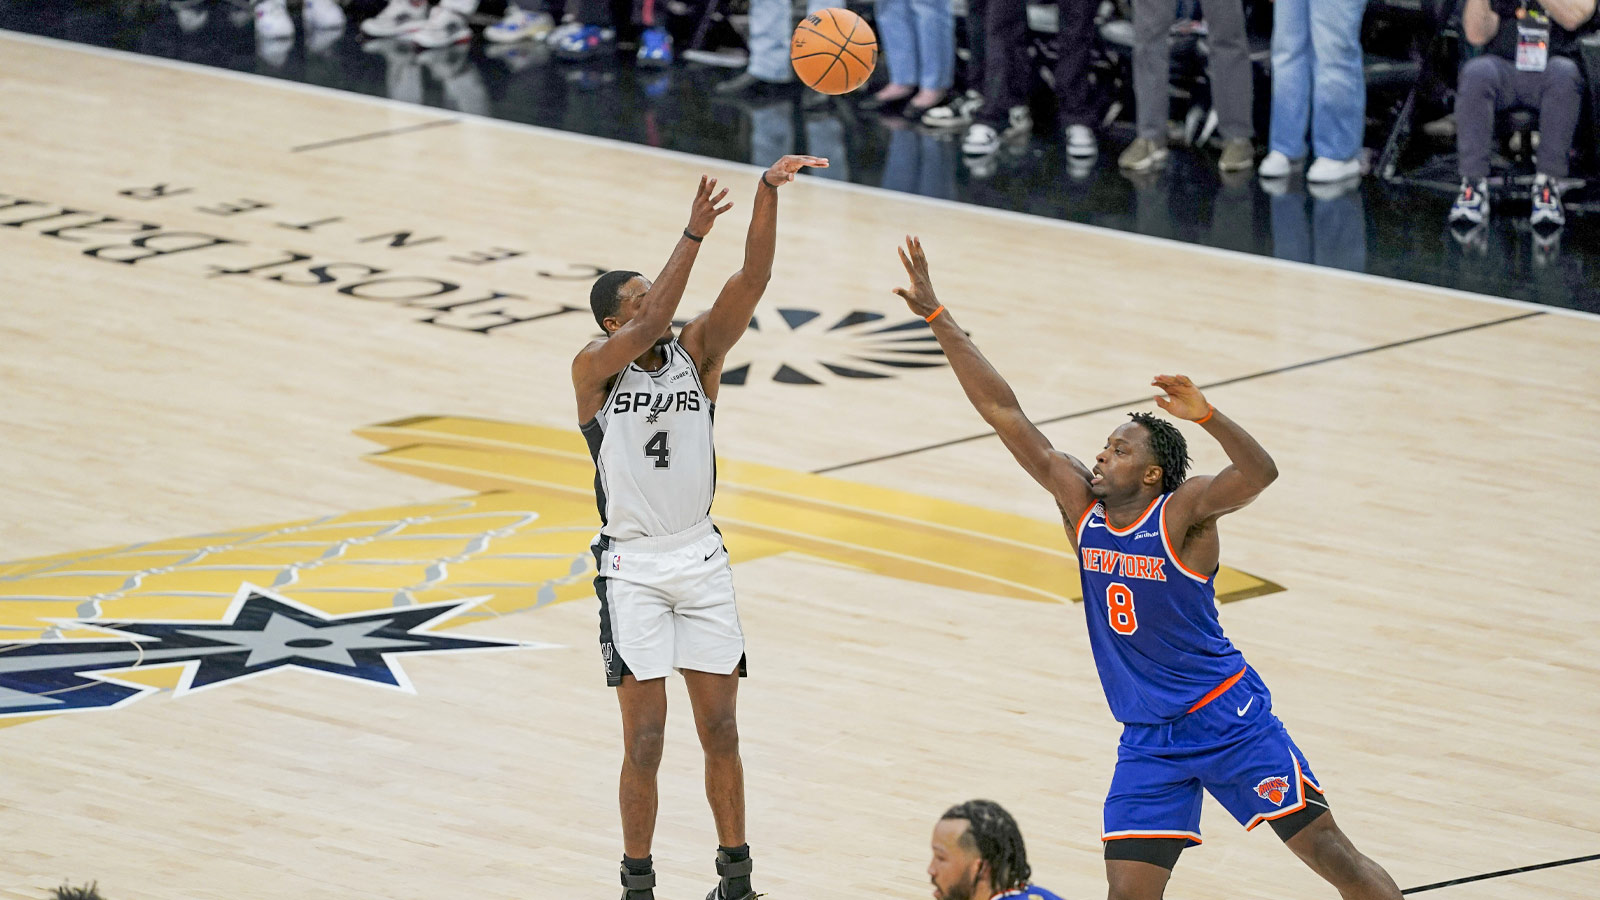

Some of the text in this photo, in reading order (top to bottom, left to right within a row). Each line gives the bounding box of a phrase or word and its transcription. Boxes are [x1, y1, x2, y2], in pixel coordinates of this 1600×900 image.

[0, 193, 250, 264] Ban
[118, 183, 608, 282] CENTER
[613, 390, 700, 424] SPURS
[643, 430, 671, 470] 4
[1081, 547, 1167, 582] NEW YORK
[1106, 582, 1138, 636] 8
